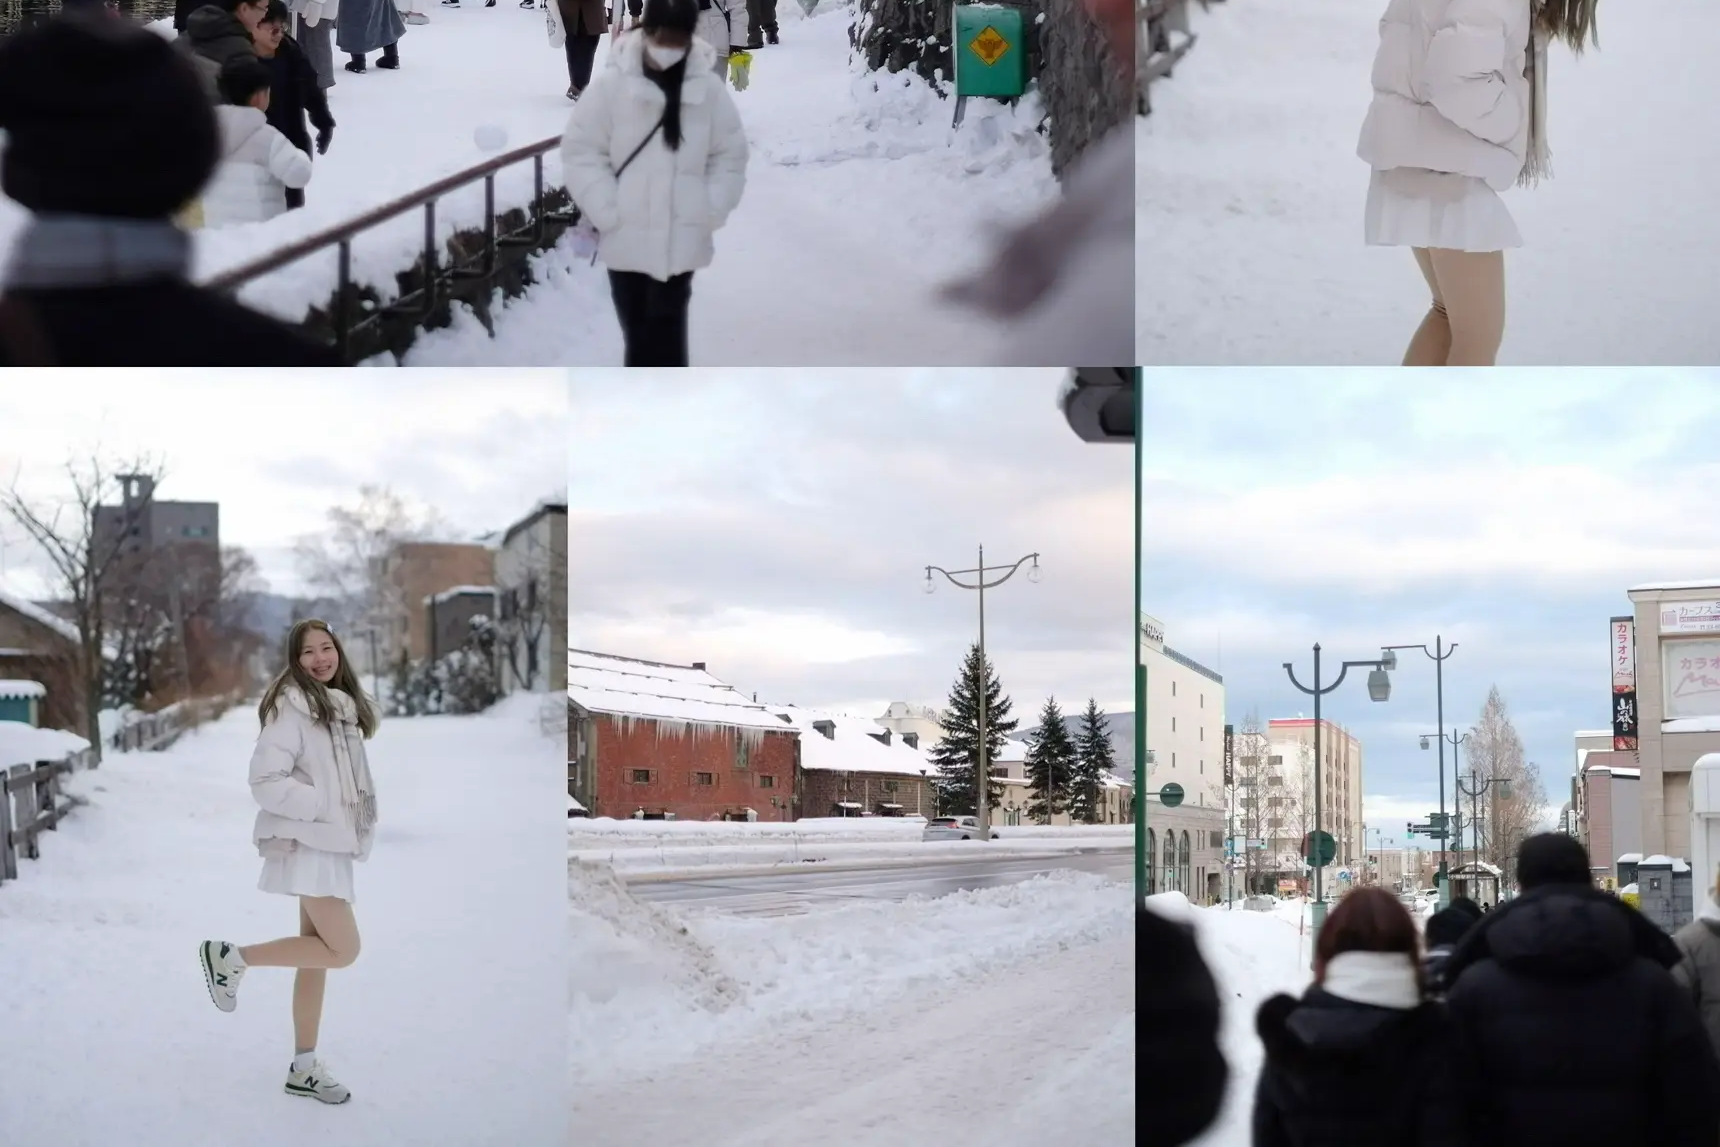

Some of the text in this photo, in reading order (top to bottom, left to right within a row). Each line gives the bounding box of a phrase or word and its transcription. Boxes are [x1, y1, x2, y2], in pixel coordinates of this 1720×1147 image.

[1617, 623, 1628, 666] カラオケ
[304, 1075, 319, 1089] N
